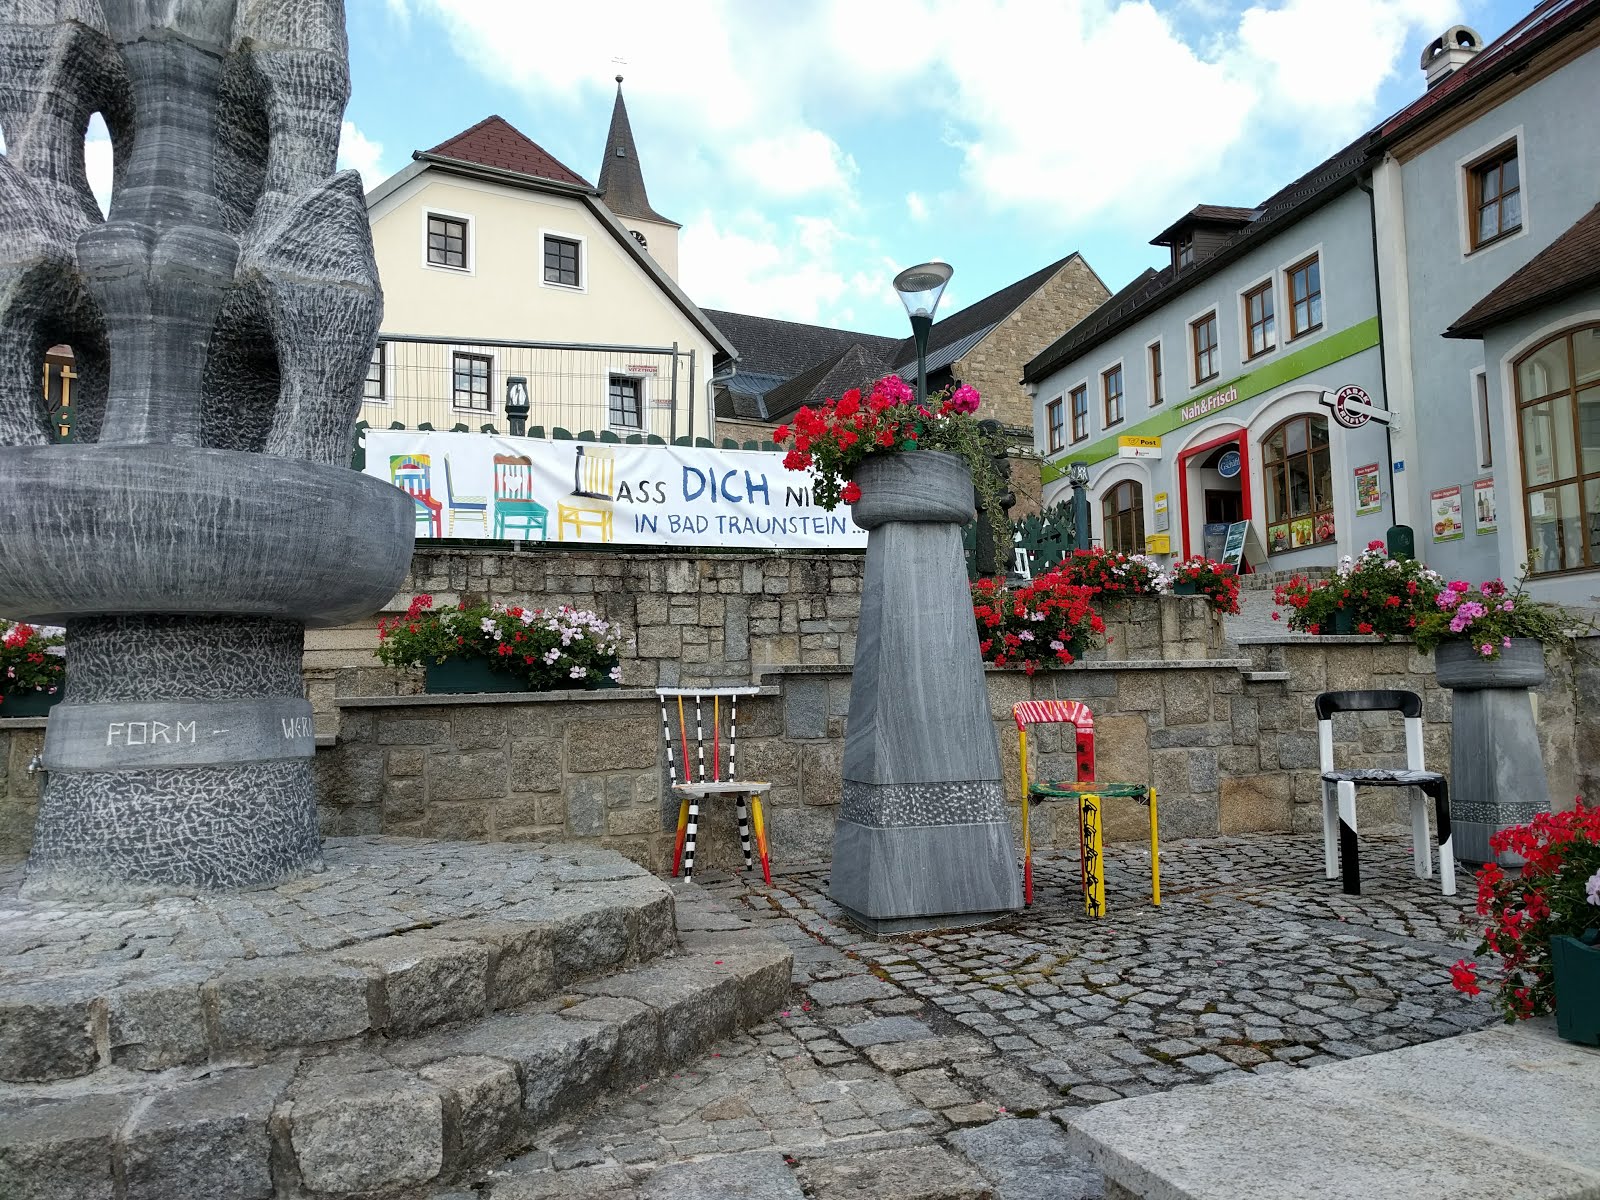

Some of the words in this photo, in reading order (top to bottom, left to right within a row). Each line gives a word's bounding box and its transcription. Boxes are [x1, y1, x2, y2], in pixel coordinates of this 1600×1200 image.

[1181, 384, 1238, 422] Nah&Frisch
[1340, 388, 1370, 403] TABAK
[1338, 404, 1366, 424] TRAFIK
[682, 465, 770, 506] DICH
[635, 513, 658, 533] IN
[668, 514, 709, 534] BAD
[106, 720, 195, 746] FORM
